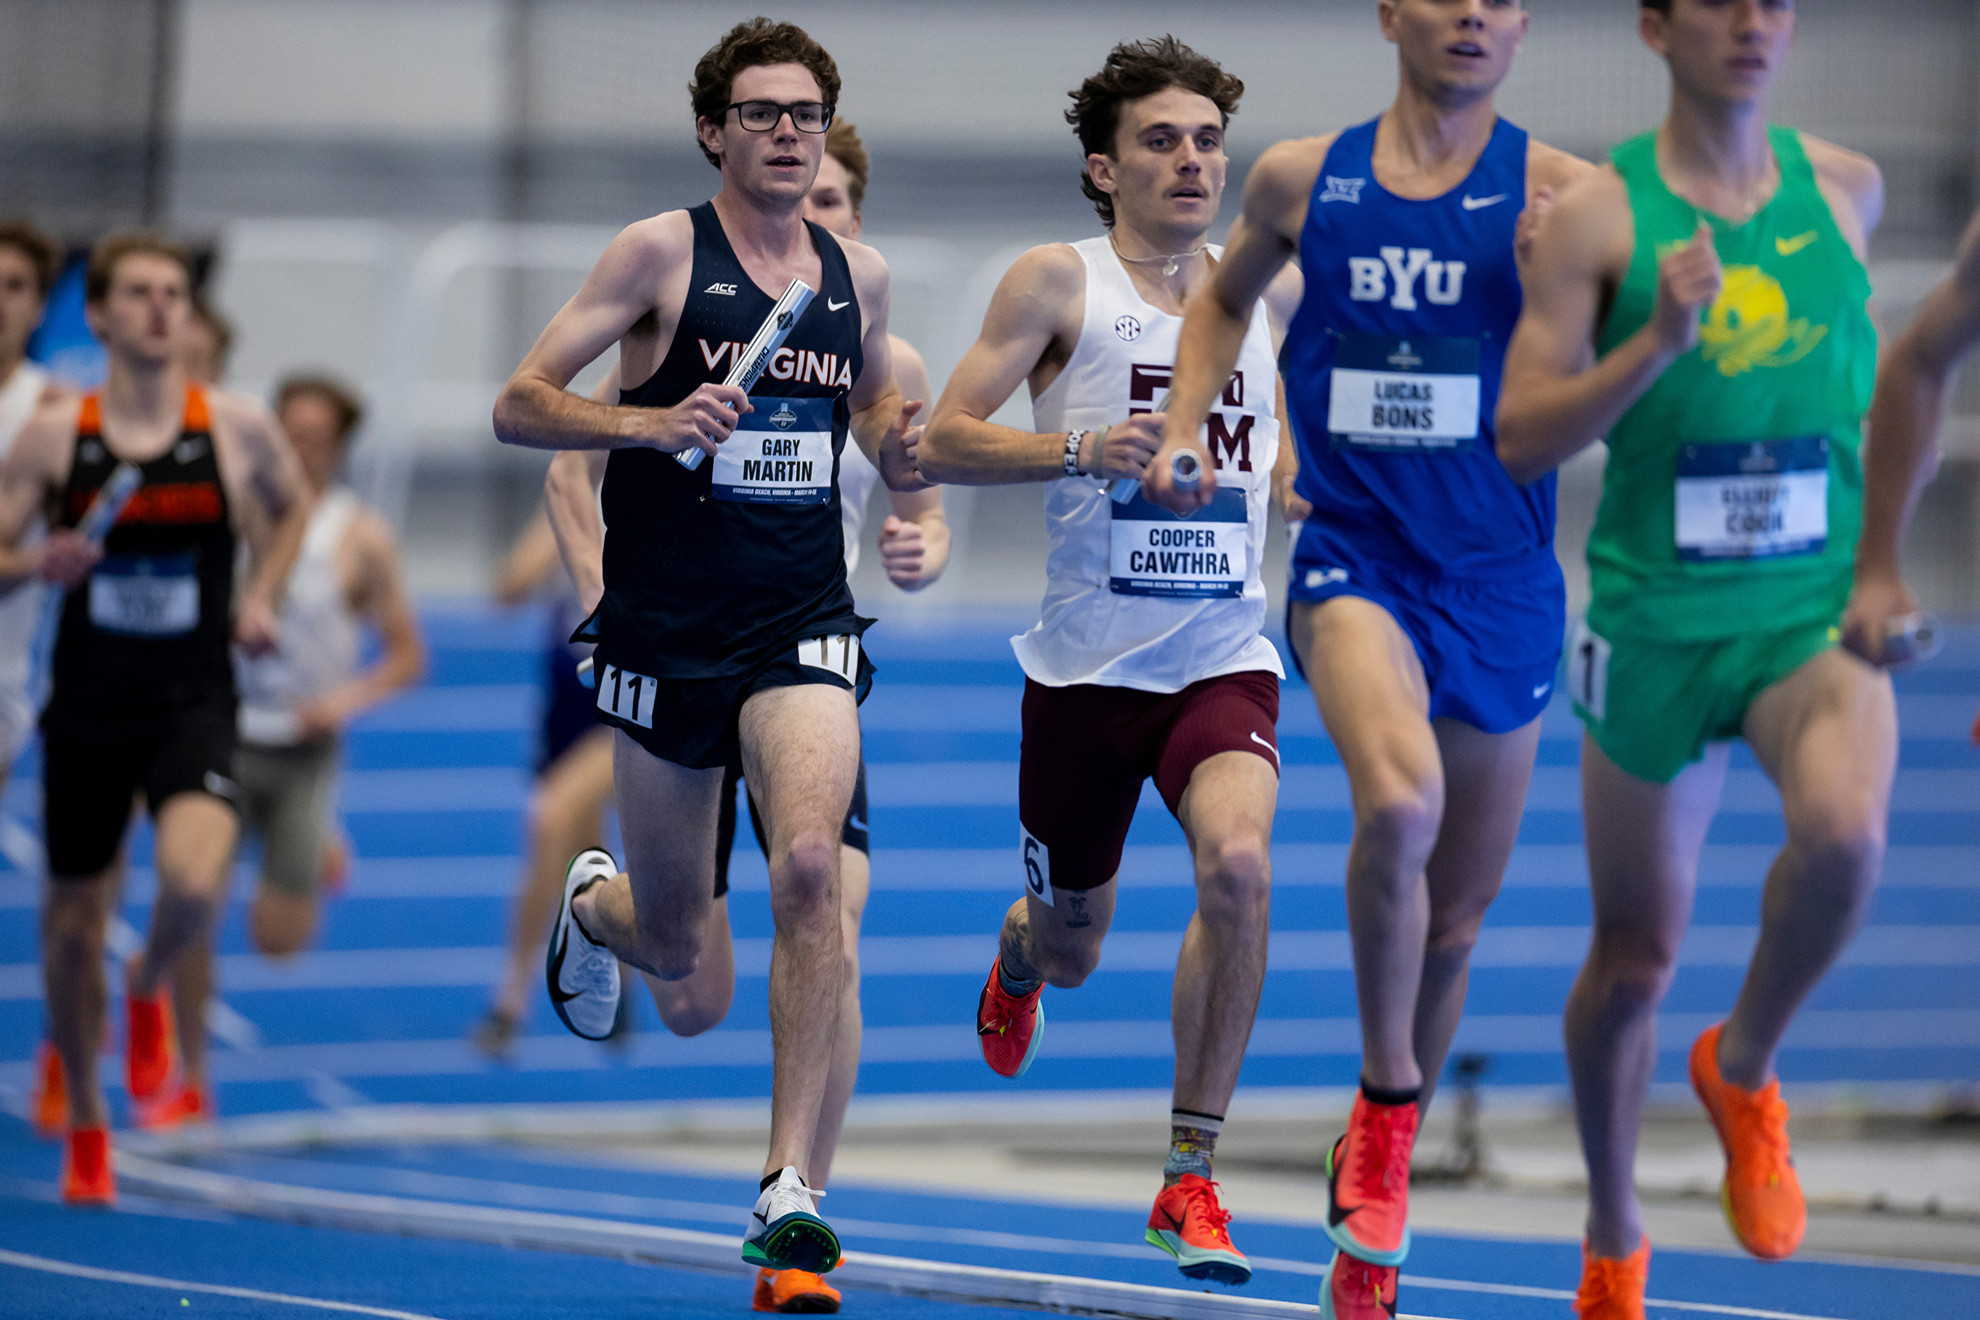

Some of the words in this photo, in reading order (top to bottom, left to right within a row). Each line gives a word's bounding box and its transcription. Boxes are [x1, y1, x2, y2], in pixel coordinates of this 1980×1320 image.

[705, 282, 738, 295] ACC
[1348, 246, 1467, 311] BYU
[1115, 315, 1141, 341] SEC
[698, 338, 852, 390] VIGINIA
[738, 346, 770, 389] CHAMPIONS
[1374, 380, 1433, 401] LUCAS
[1372, 404, 1434, 430] BONS
[762, 439, 800, 456] GARY
[743, 460, 813, 482] MARTIN
[1149, 528, 1215, 547] COOPER
[1130, 551, 1230, 575] CAWTHRA
[610, 667, 643, 721] 11
[1024, 836, 1044, 895] 6
